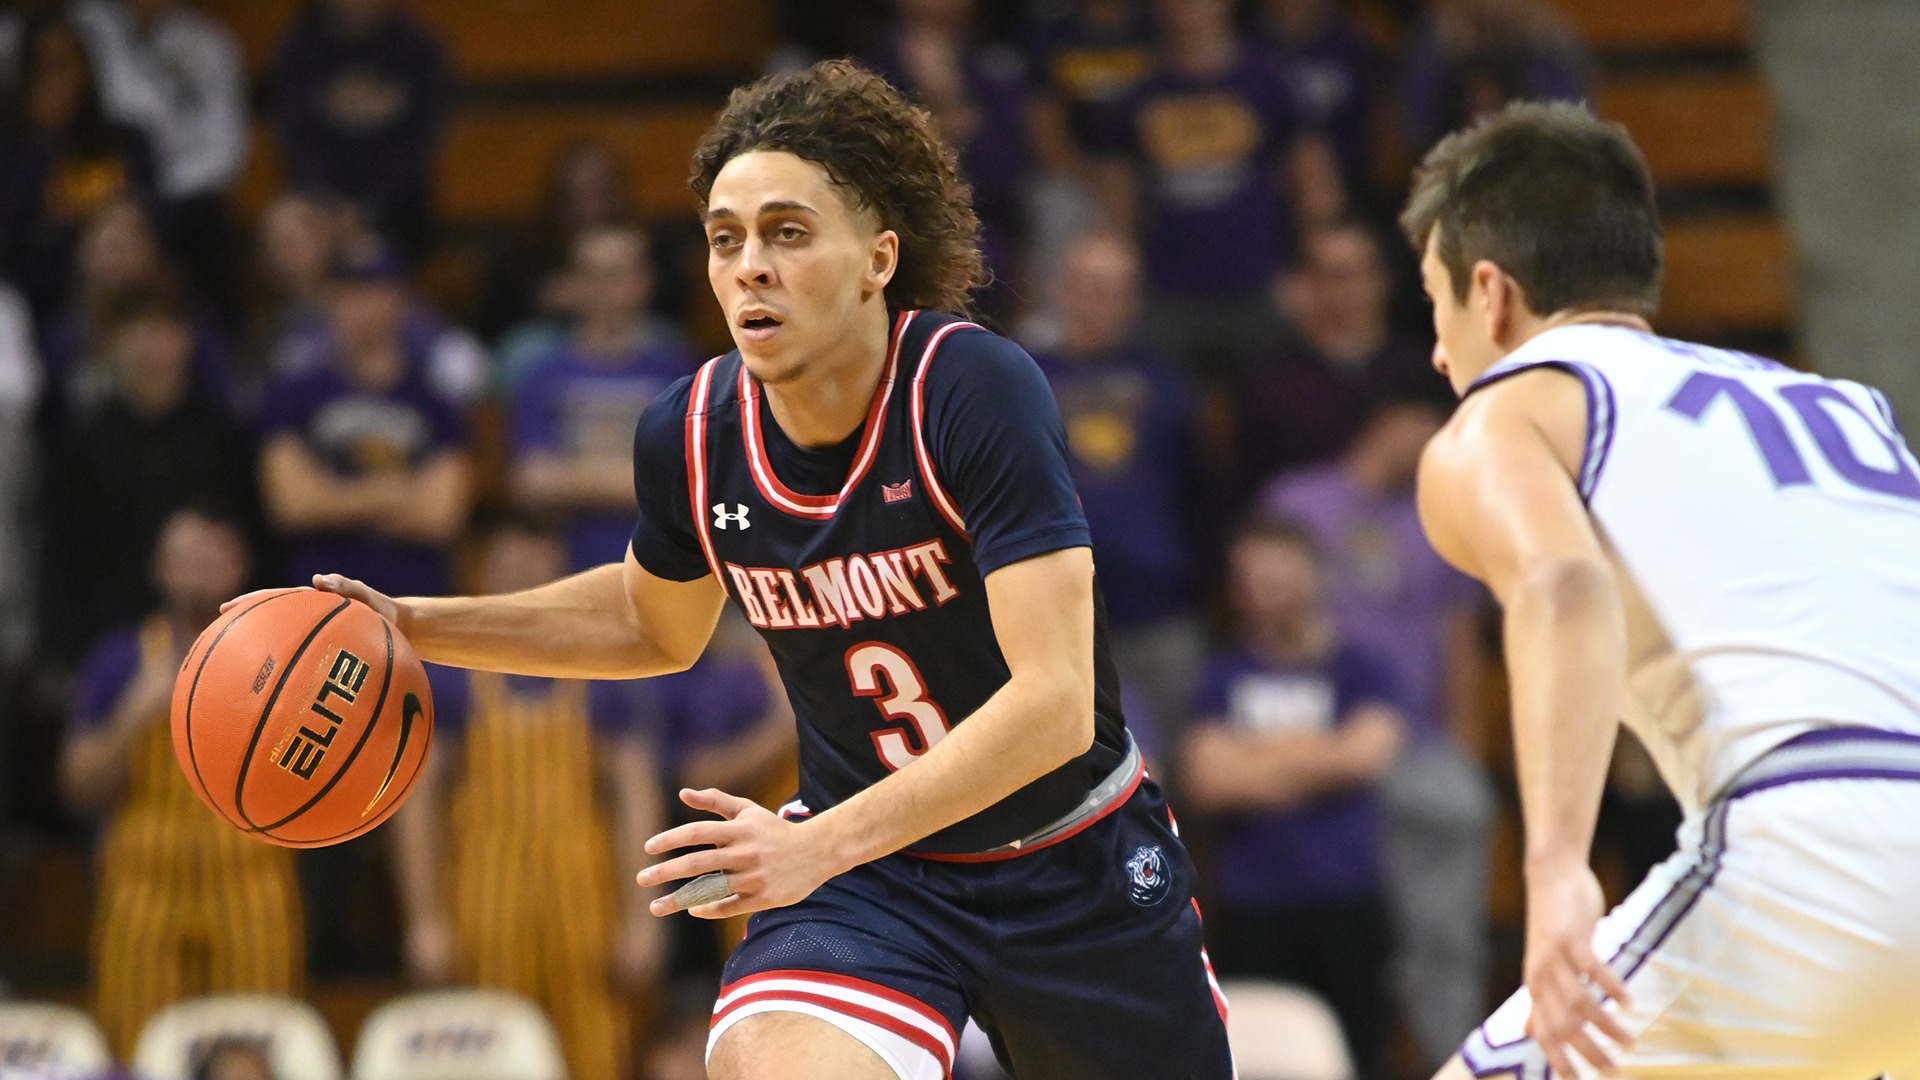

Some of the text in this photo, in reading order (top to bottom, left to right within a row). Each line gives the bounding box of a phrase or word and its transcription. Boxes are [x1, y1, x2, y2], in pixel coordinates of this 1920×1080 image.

[1664, 370, 1920, 499] 10
[725, 538, 960, 629] BELMONT
[277, 648, 370, 780] ELITE
[844, 640, 952, 773] 3
